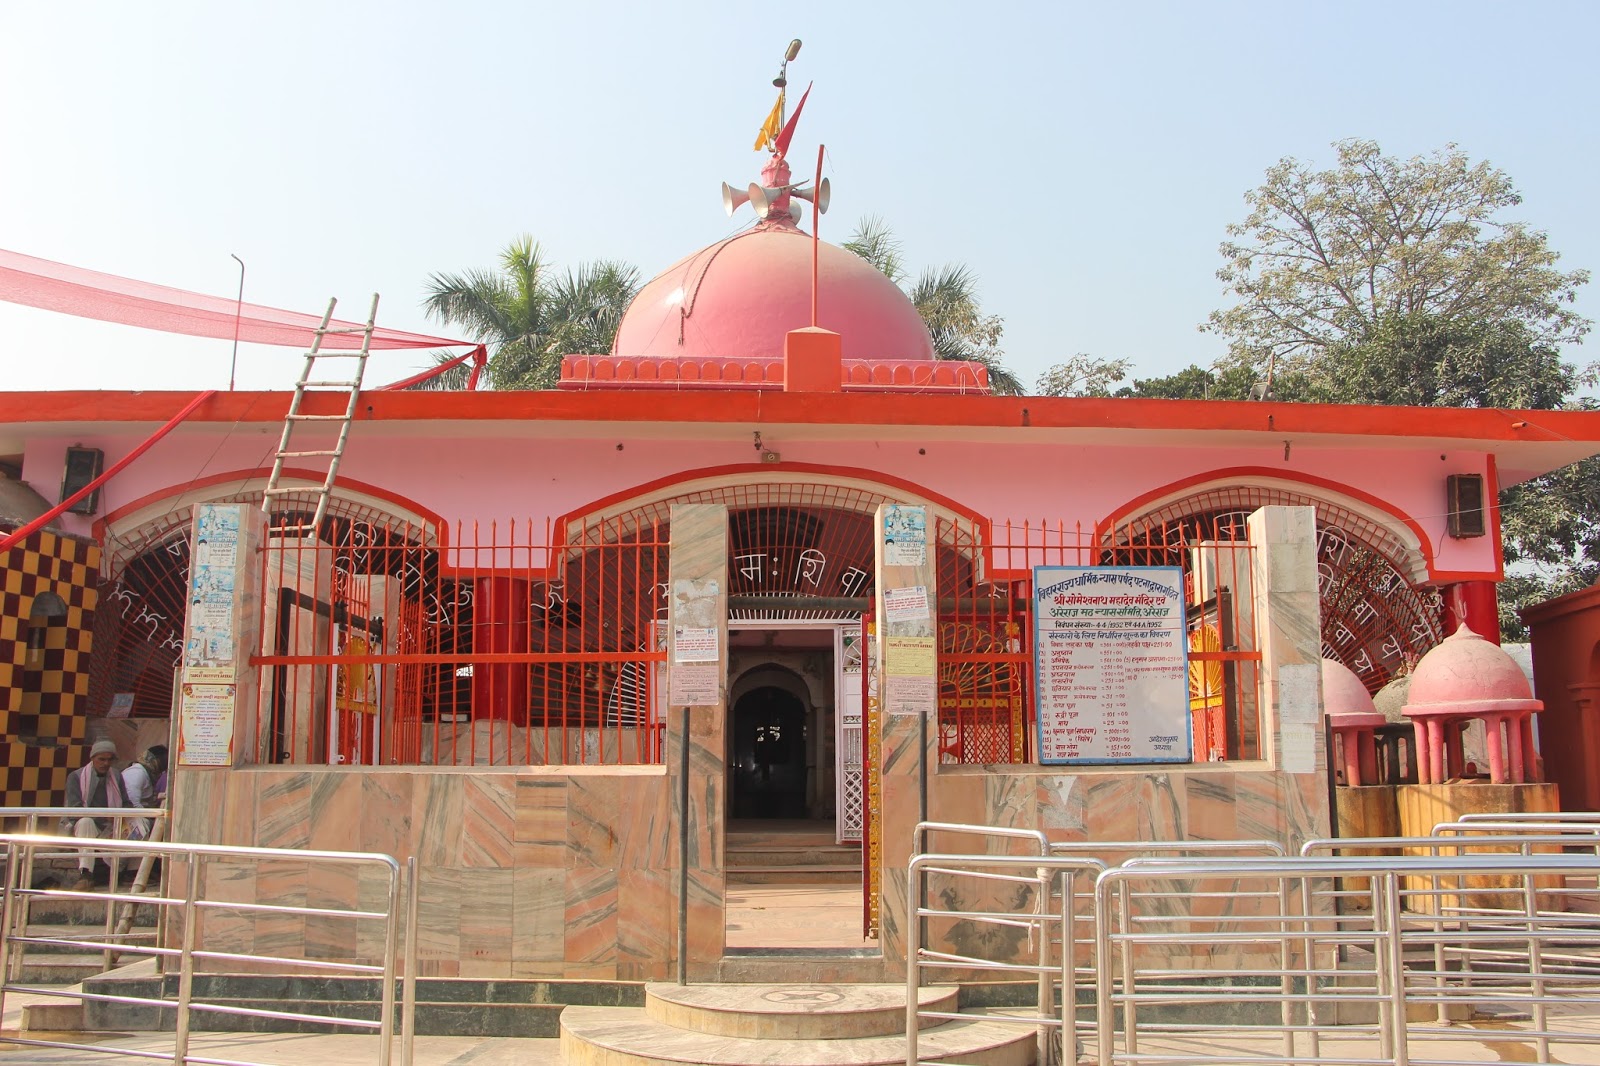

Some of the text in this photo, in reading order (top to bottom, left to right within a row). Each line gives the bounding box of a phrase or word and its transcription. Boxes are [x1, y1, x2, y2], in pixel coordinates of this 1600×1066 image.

[1074, 572, 1099, 587] धार्मिक
[1099, 574, 1117, 585] न्यास
[1134, 577, 1150, 589] पटना
[1054, 593, 1065, 606] श्री
[1109, 594, 1134, 606] महादेव
[1135, 594, 1155, 606] मंदिर
[1155, 595, 1167, 605] एवं
[1049, 606, 1079, 617] अरेराज
[1080, 609, 1094, 617] मठ
[1095, 608, 1117, 617] न्यास
[1142, 606, 1171, 617] अरेराज
[1073, 631, 1081, 640] के
[1081, 631, 1096, 640] लिए
